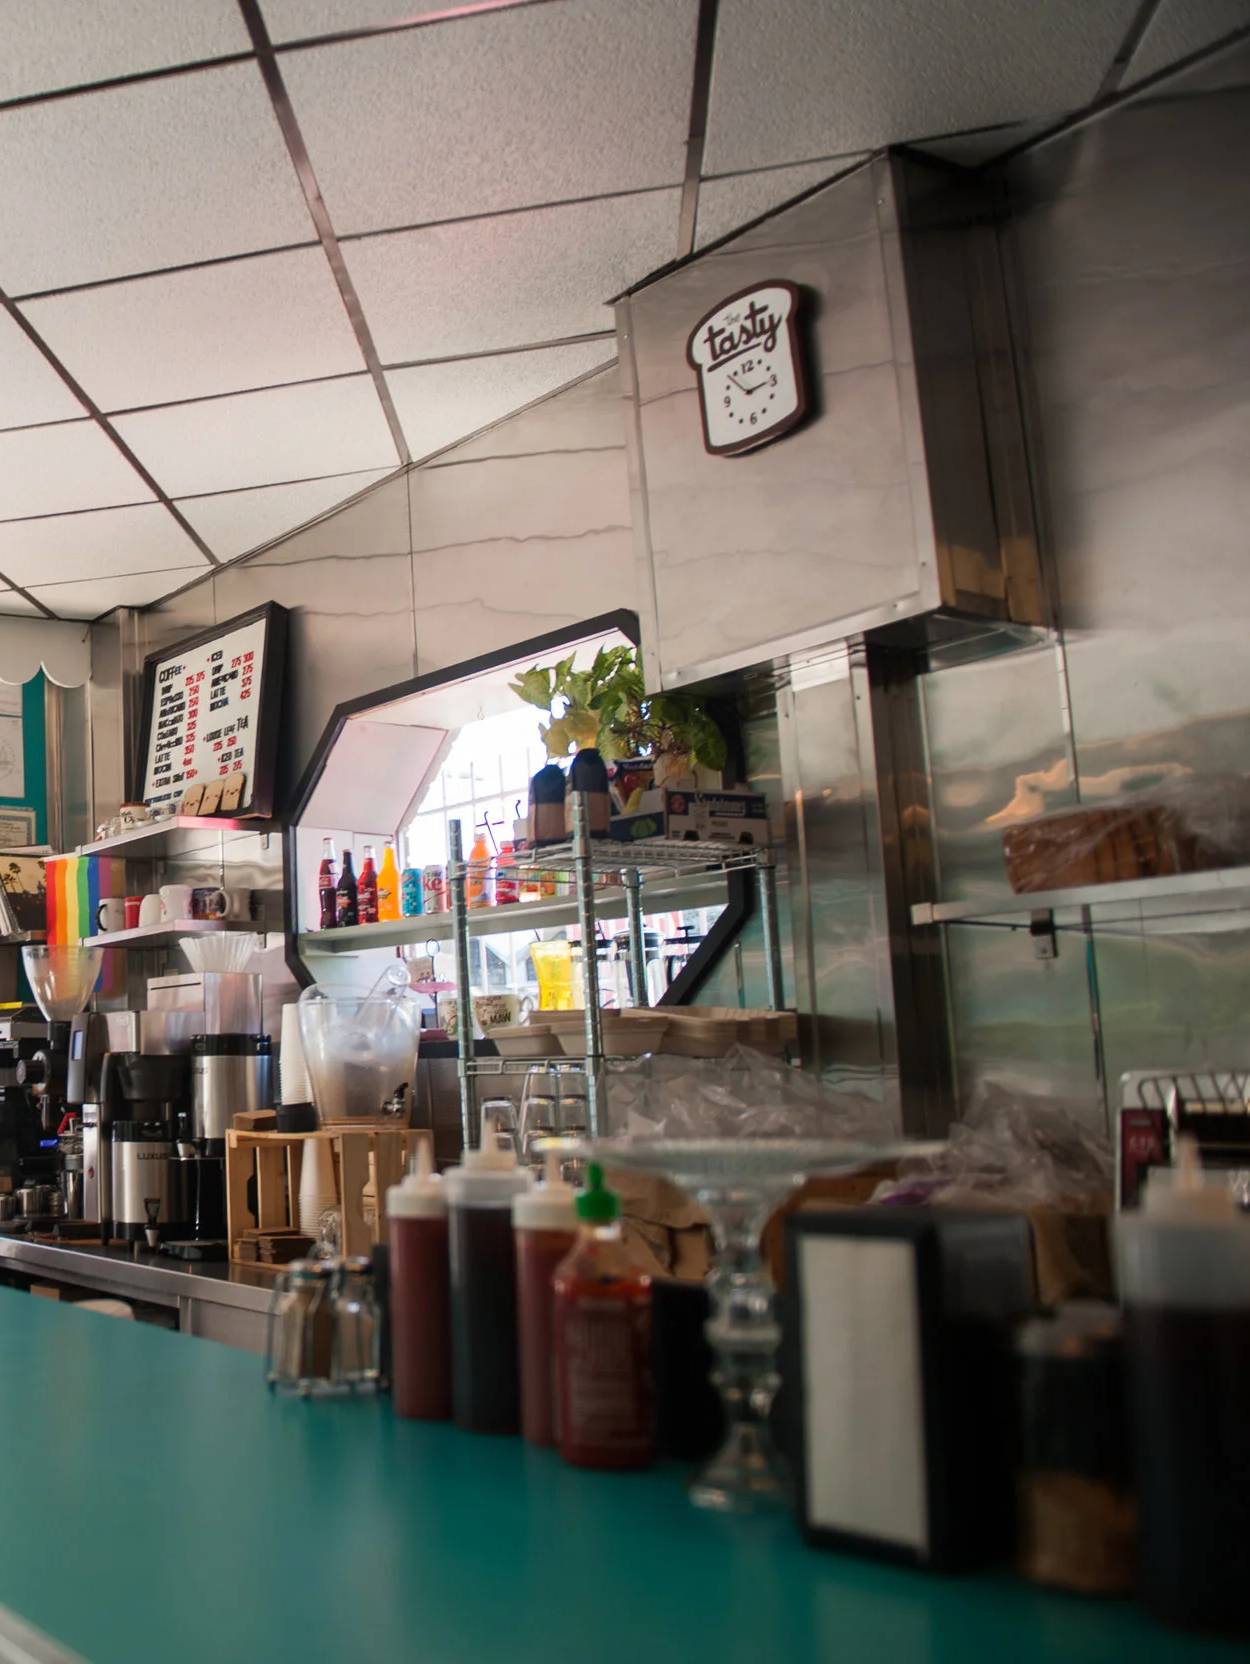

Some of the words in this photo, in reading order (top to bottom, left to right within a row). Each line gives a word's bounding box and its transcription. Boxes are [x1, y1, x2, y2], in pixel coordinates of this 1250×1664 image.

[704, 301, 782, 361] tasty
[741, 360, 754, 374] 12
[769, 374, 778, 387] 3
[724, 396, 731, 408] 9
[750, 412, 757, 424] 6
[159, 665, 182, 683] COFFEE
[211, 686, 226, 699] LATTE
[237, 715, 248, 731] TEA
[155, 752, 171, 764] LATTE
[234, 747, 244, 759] TEA
